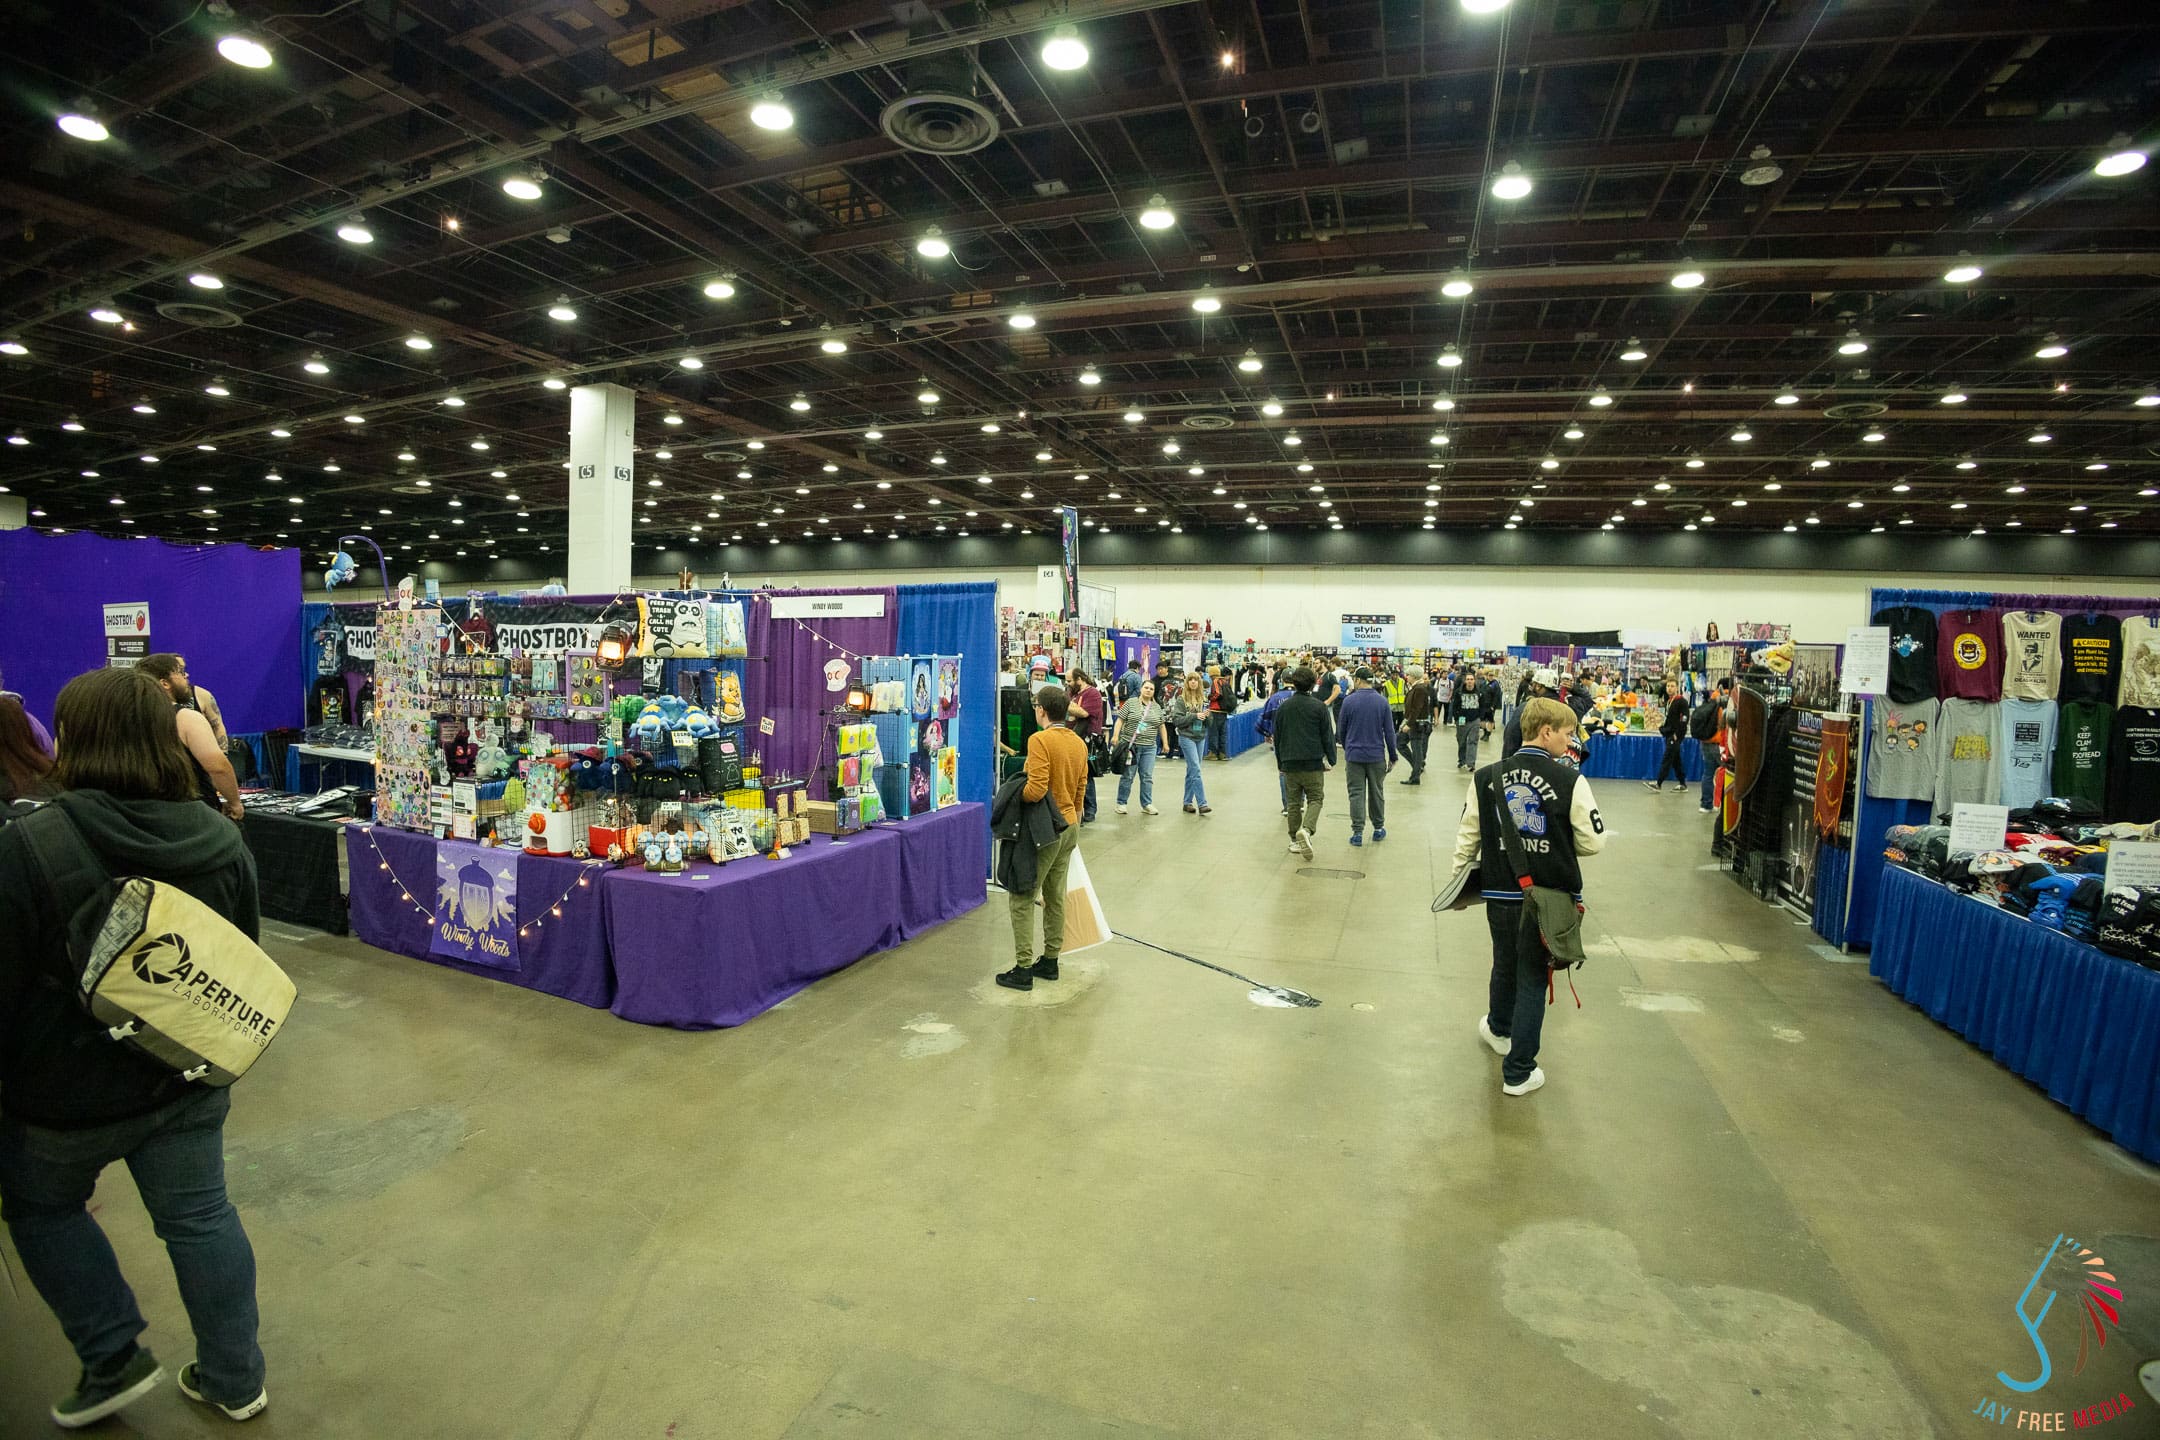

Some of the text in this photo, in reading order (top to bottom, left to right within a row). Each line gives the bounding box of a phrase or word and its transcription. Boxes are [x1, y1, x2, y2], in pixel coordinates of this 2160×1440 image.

[581, 466, 592, 478] C5
[617, 468, 628, 481] C5
[106, 615, 133, 626] GHOSTBOY
[1354, 626, 1382, 634] stylin
[500, 627, 589, 649] GHOSTBOY
[2017, 631, 2051, 639] WANTED
[1488, 768, 1559, 801] ETROIT
[1589, 808, 1605, 835] 6
[1499, 836, 1551, 854] LNS
[441, 921, 511, 958] Windy Woods
[168, 961, 276, 1037] APERTURE
[172, 983, 268, 1048] LABORATORIES
